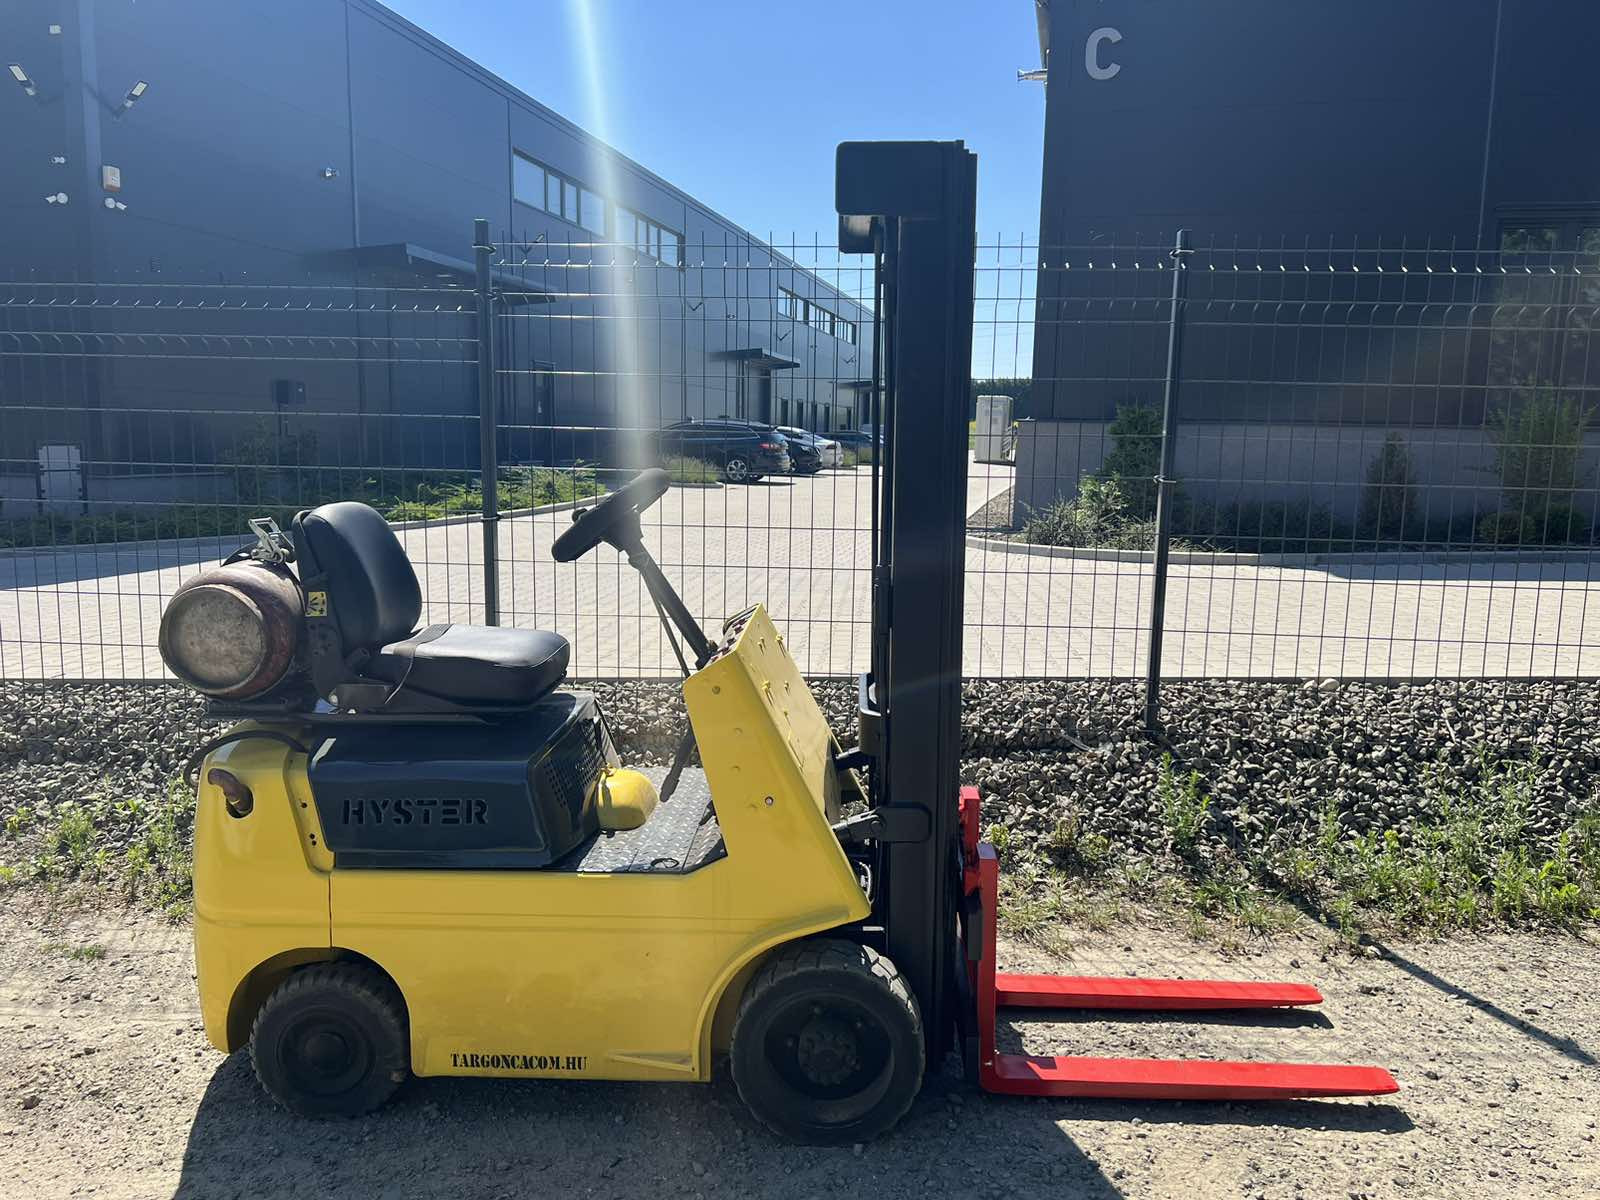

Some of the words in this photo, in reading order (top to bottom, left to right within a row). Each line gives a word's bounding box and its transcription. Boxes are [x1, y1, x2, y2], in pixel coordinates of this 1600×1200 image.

[1085, 27, 1122, 80] C
[342, 799, 489, 825] HYSTER
[450, 1053, 588, 1070] TARGONCACOM.HU
